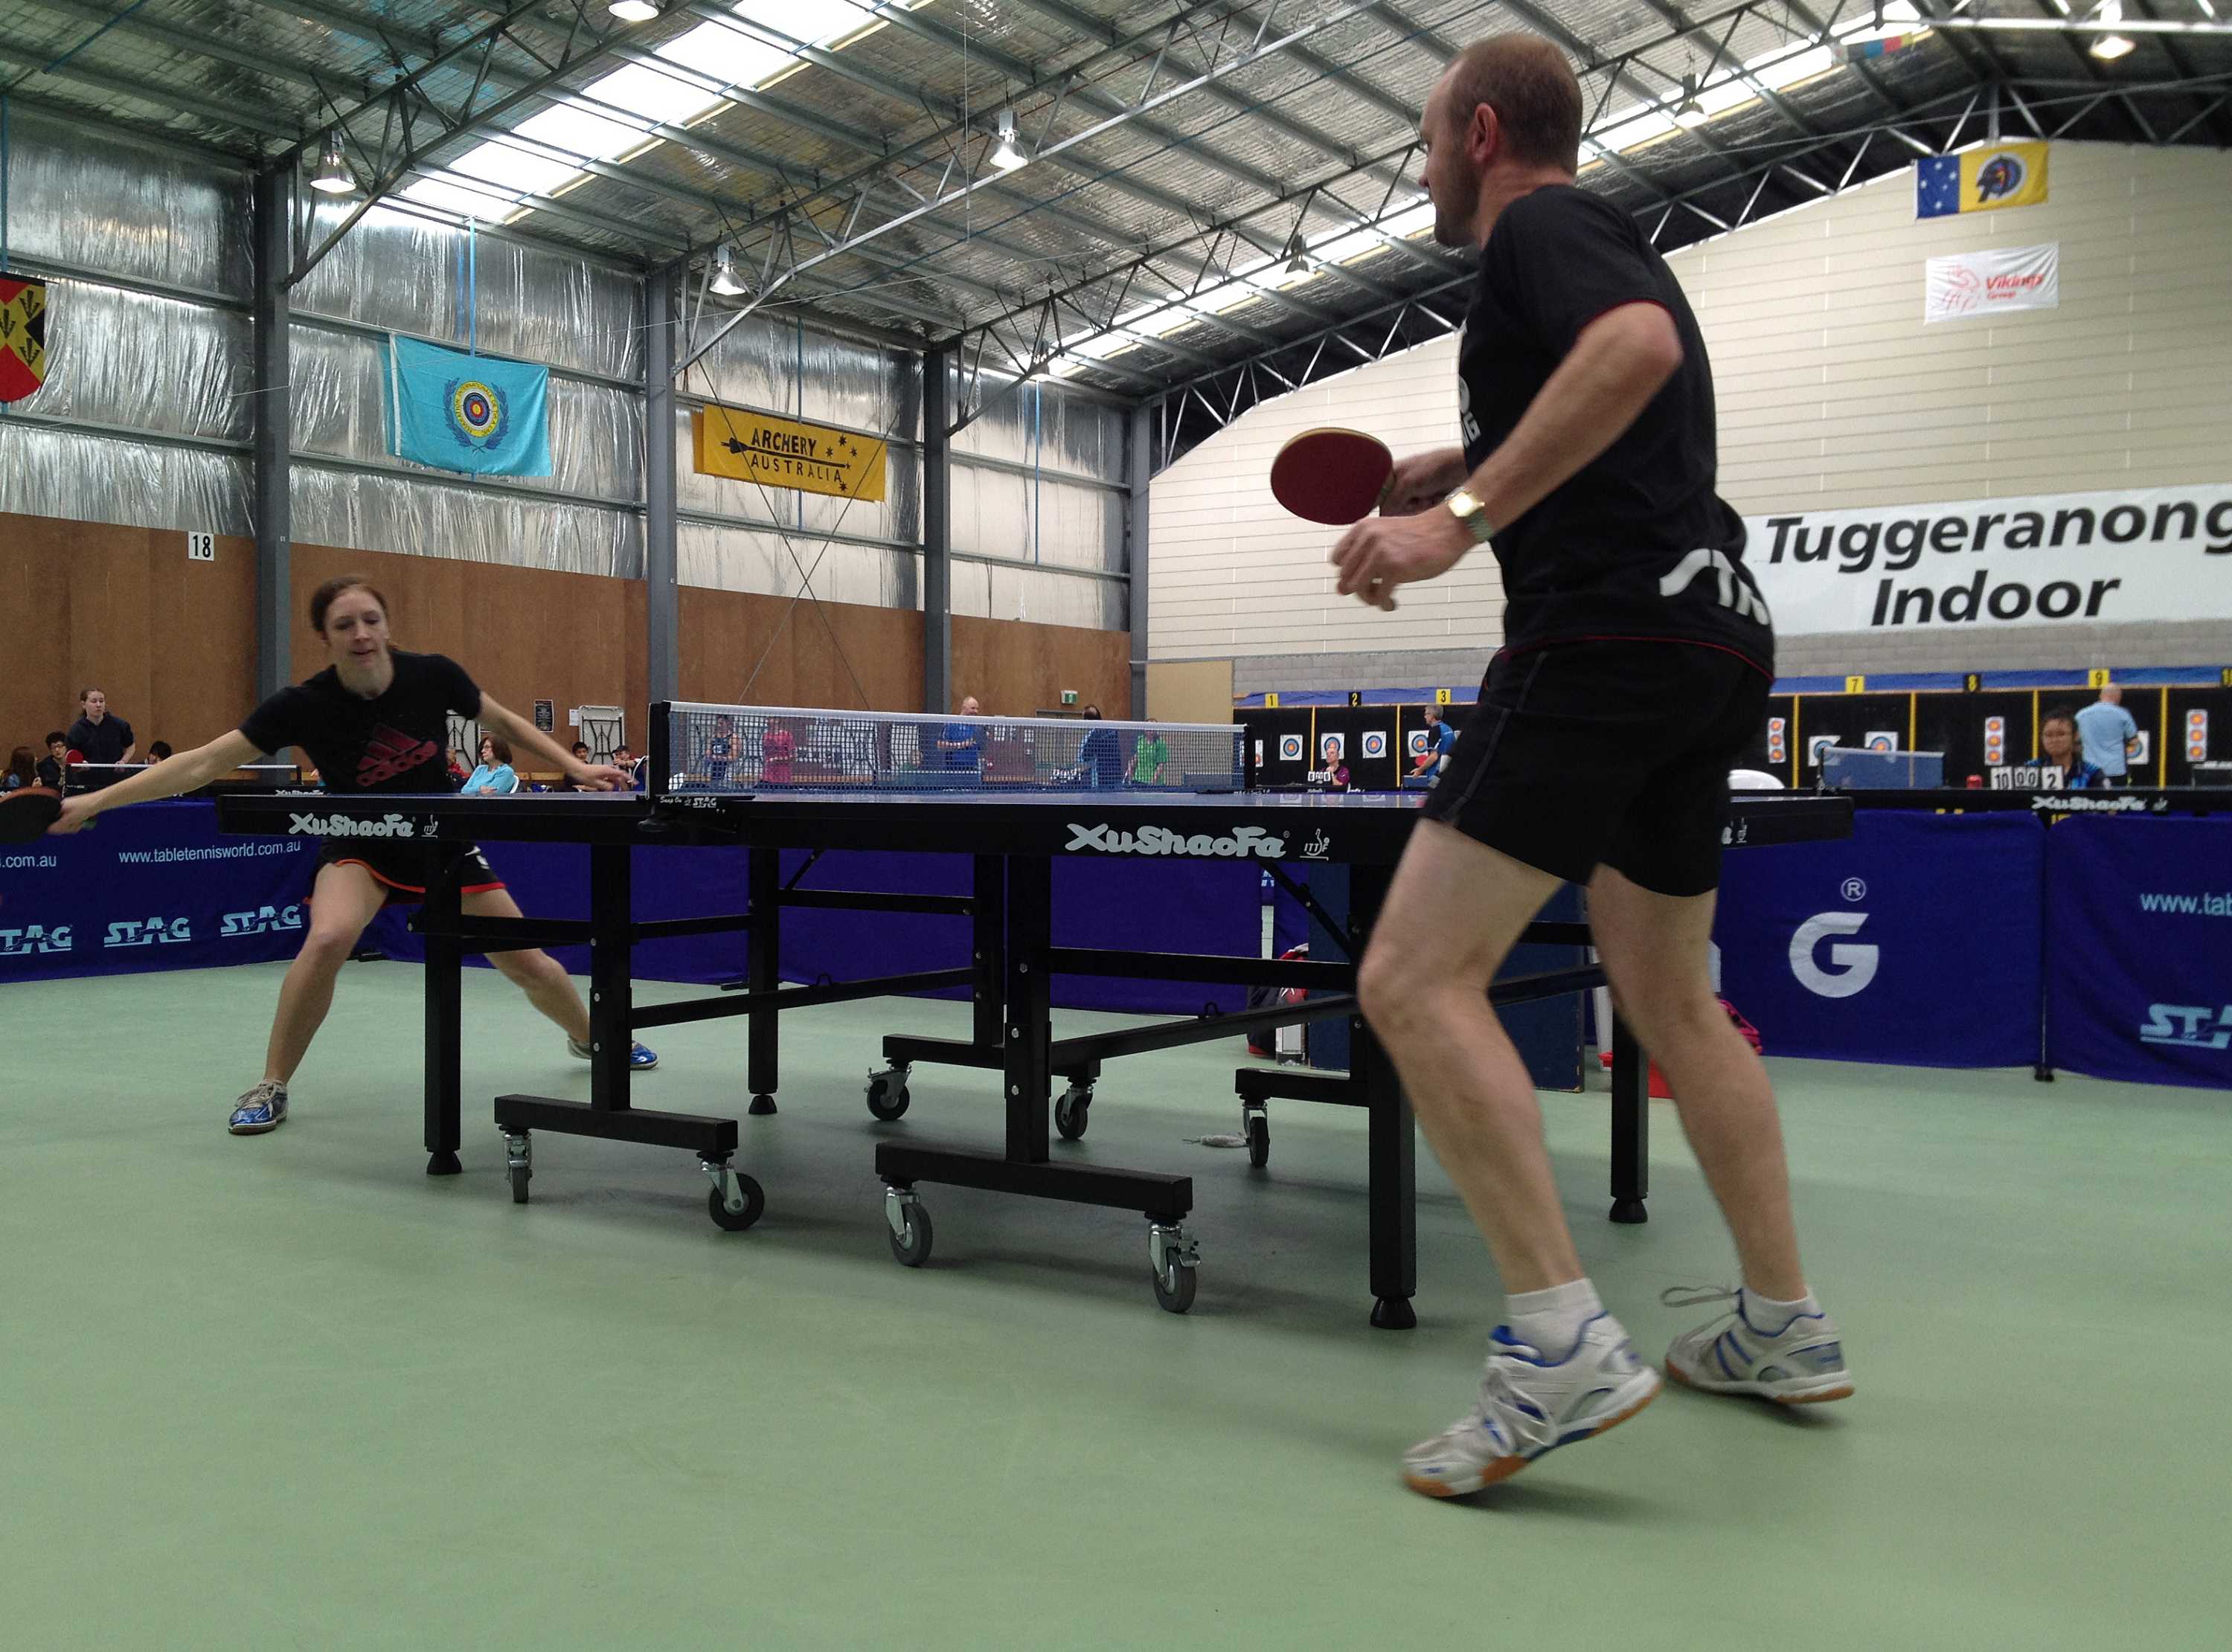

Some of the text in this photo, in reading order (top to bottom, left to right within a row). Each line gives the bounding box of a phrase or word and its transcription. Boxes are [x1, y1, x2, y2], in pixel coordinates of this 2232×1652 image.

[751, 428, 817, 457] ARCHERY
[751, 454, 842, 482] AUSTRALIA
[193, 535, 211, 558] 18
[1870, 570, 2121, 626] Indoor
[1851, 678, 1859, 692] 7
[1968, 674, 1978, 692] 8
[2094, 672, 2103, 686] 9
[1351, 692, 1358, 707] 2
[1440, 690, 1446, 702] 3
[2047, 774, 2056, 788] 2
[693, 797, 716, 808] STAG
[2032, 796, 2147, 811] XuShaoFa
[288, 813, 414, 838] XuShaoFa
[1065, 823, 1329, 858] XuShaoFa ITTF
[118, 840, 301, 864] www.tabletennisworld.com.au
[0, 904, 303, 956] TAG STAG STAG
